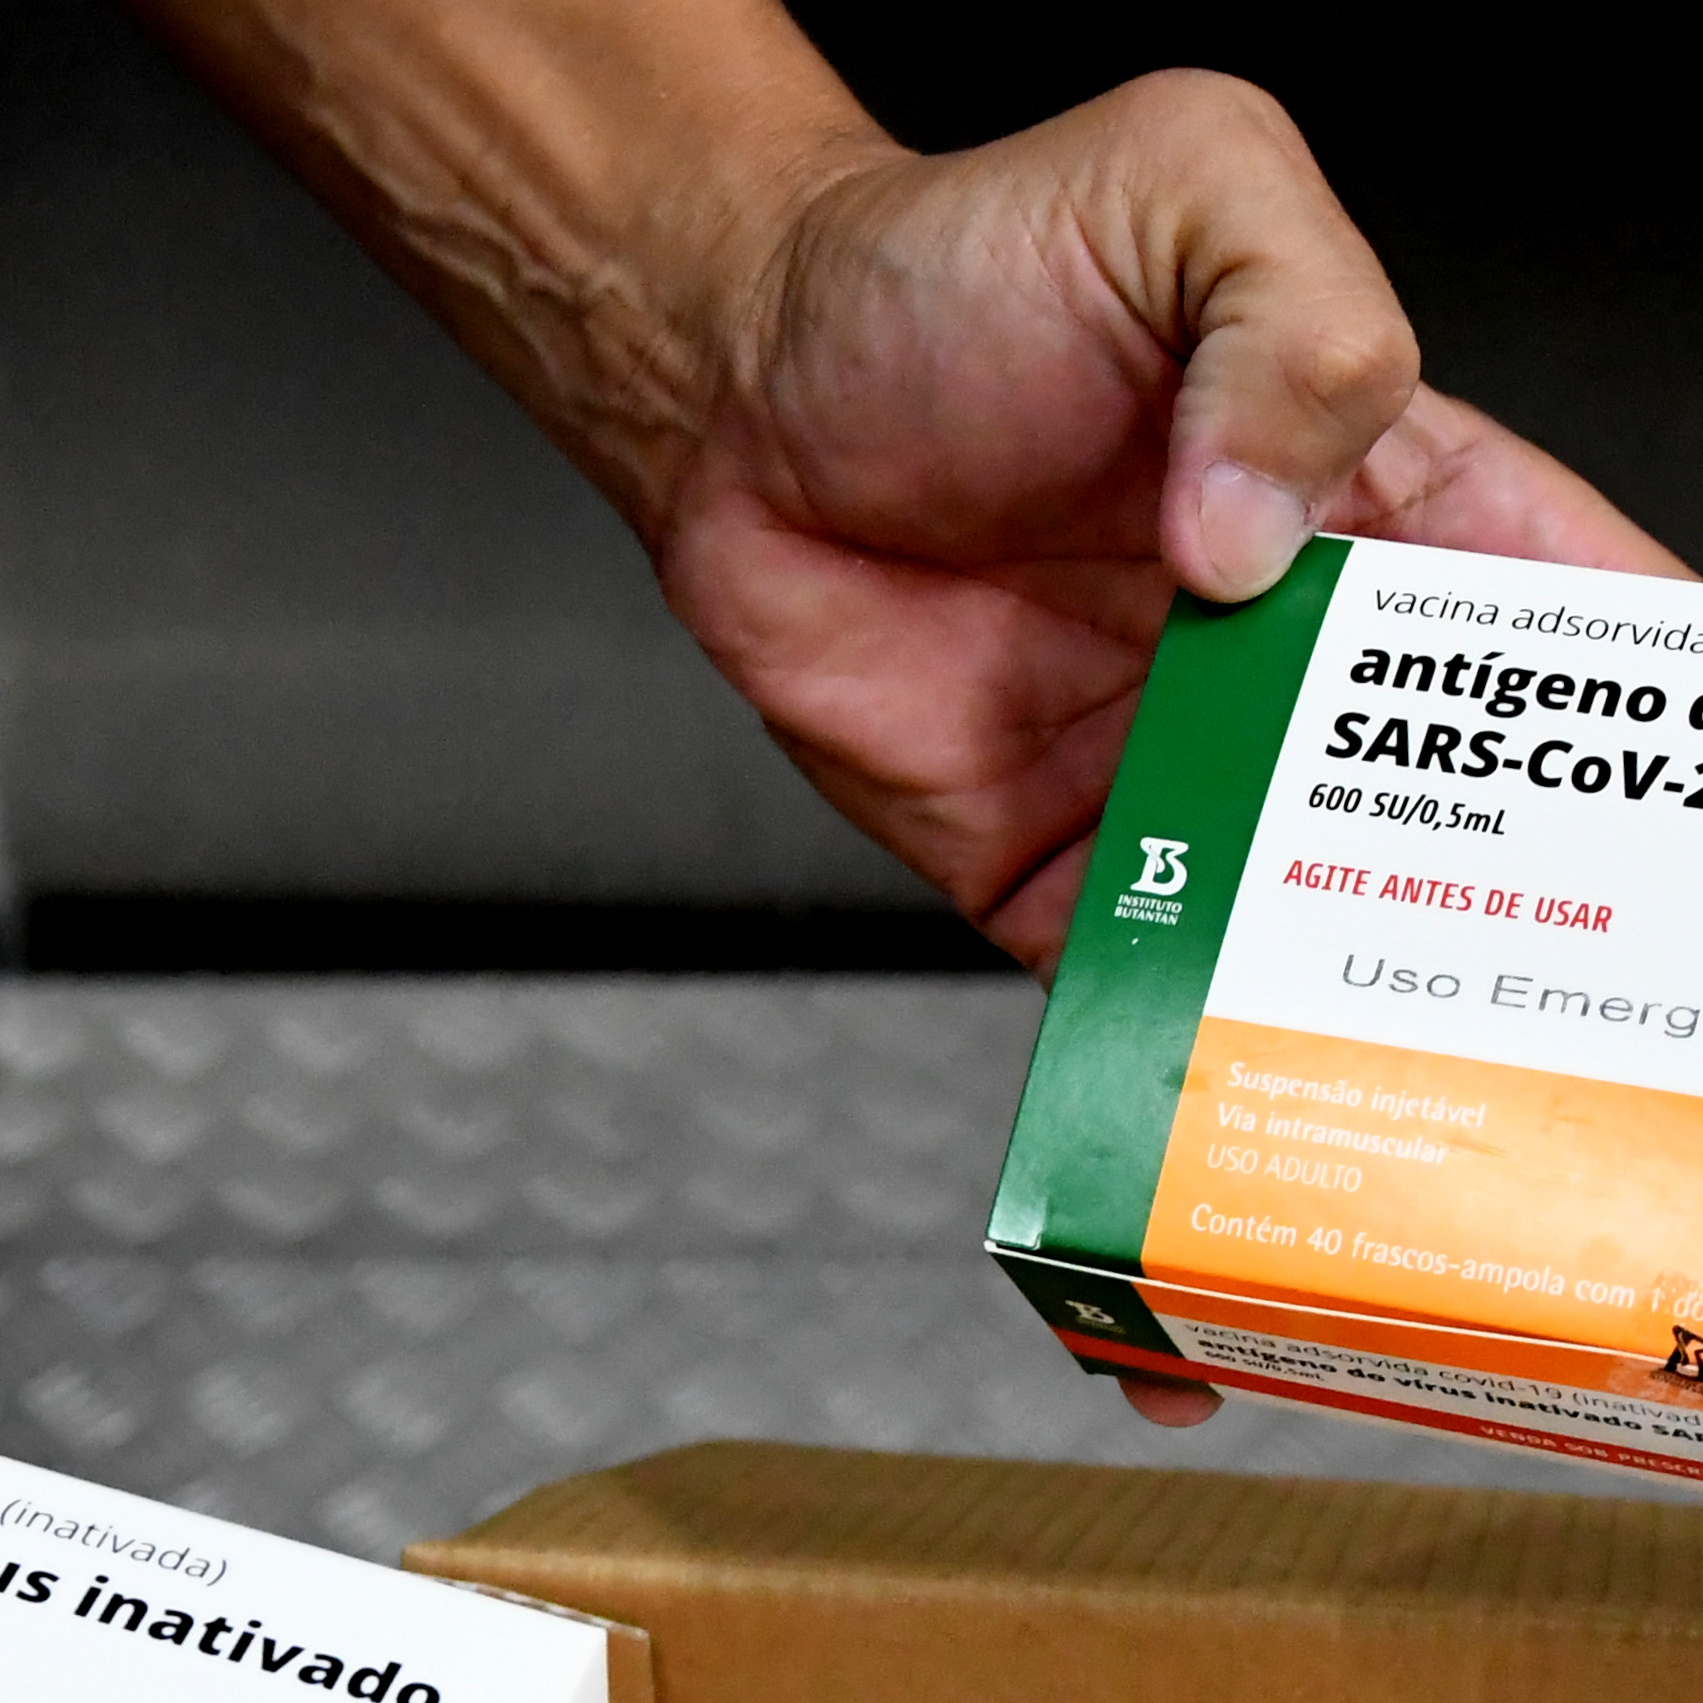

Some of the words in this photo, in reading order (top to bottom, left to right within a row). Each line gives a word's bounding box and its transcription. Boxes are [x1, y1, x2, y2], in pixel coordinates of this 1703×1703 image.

[1376, 589, 1500, 626] vacina
[1349, 648, 1667, 723] antígeno
[1308, 783, 1363, 814] 600
[1368, 792, 1506, 836] SU/0,5mL
[1114, 906, 1178, 926] BUTANTAN
[1118, 894, 1182, 913] INSTITUTO
[1282, 859, 1372, 896] AGITE
[1378, 874, 1476, 912] ANTES
[1483, 889, 1525, 919] DE
[1534, 896, 1613, 934] USAR
[1342, 953, 1461, 999] Uso
[1226, 1060, 1364, 1108] Suspensão
[1370, 1085, 1488, 1129] injetável
[1217, 1101, 1257, 1132] Via
[1265, 1110, 1453, 1166] intramuscular
[1206, 1143, 1260, 1175] USO
[1264, 1153, 1364, 1193] ADULTO
[1190, 1202, 1298, 1248] Contém
[1306, 1226, 1343, 1256] 40
[1351, 1231, 1566, 1296] frascos-ampola
[1574, 1279, 1636, 1309] com
[0, 1499, 227, 1587] (inativada)
